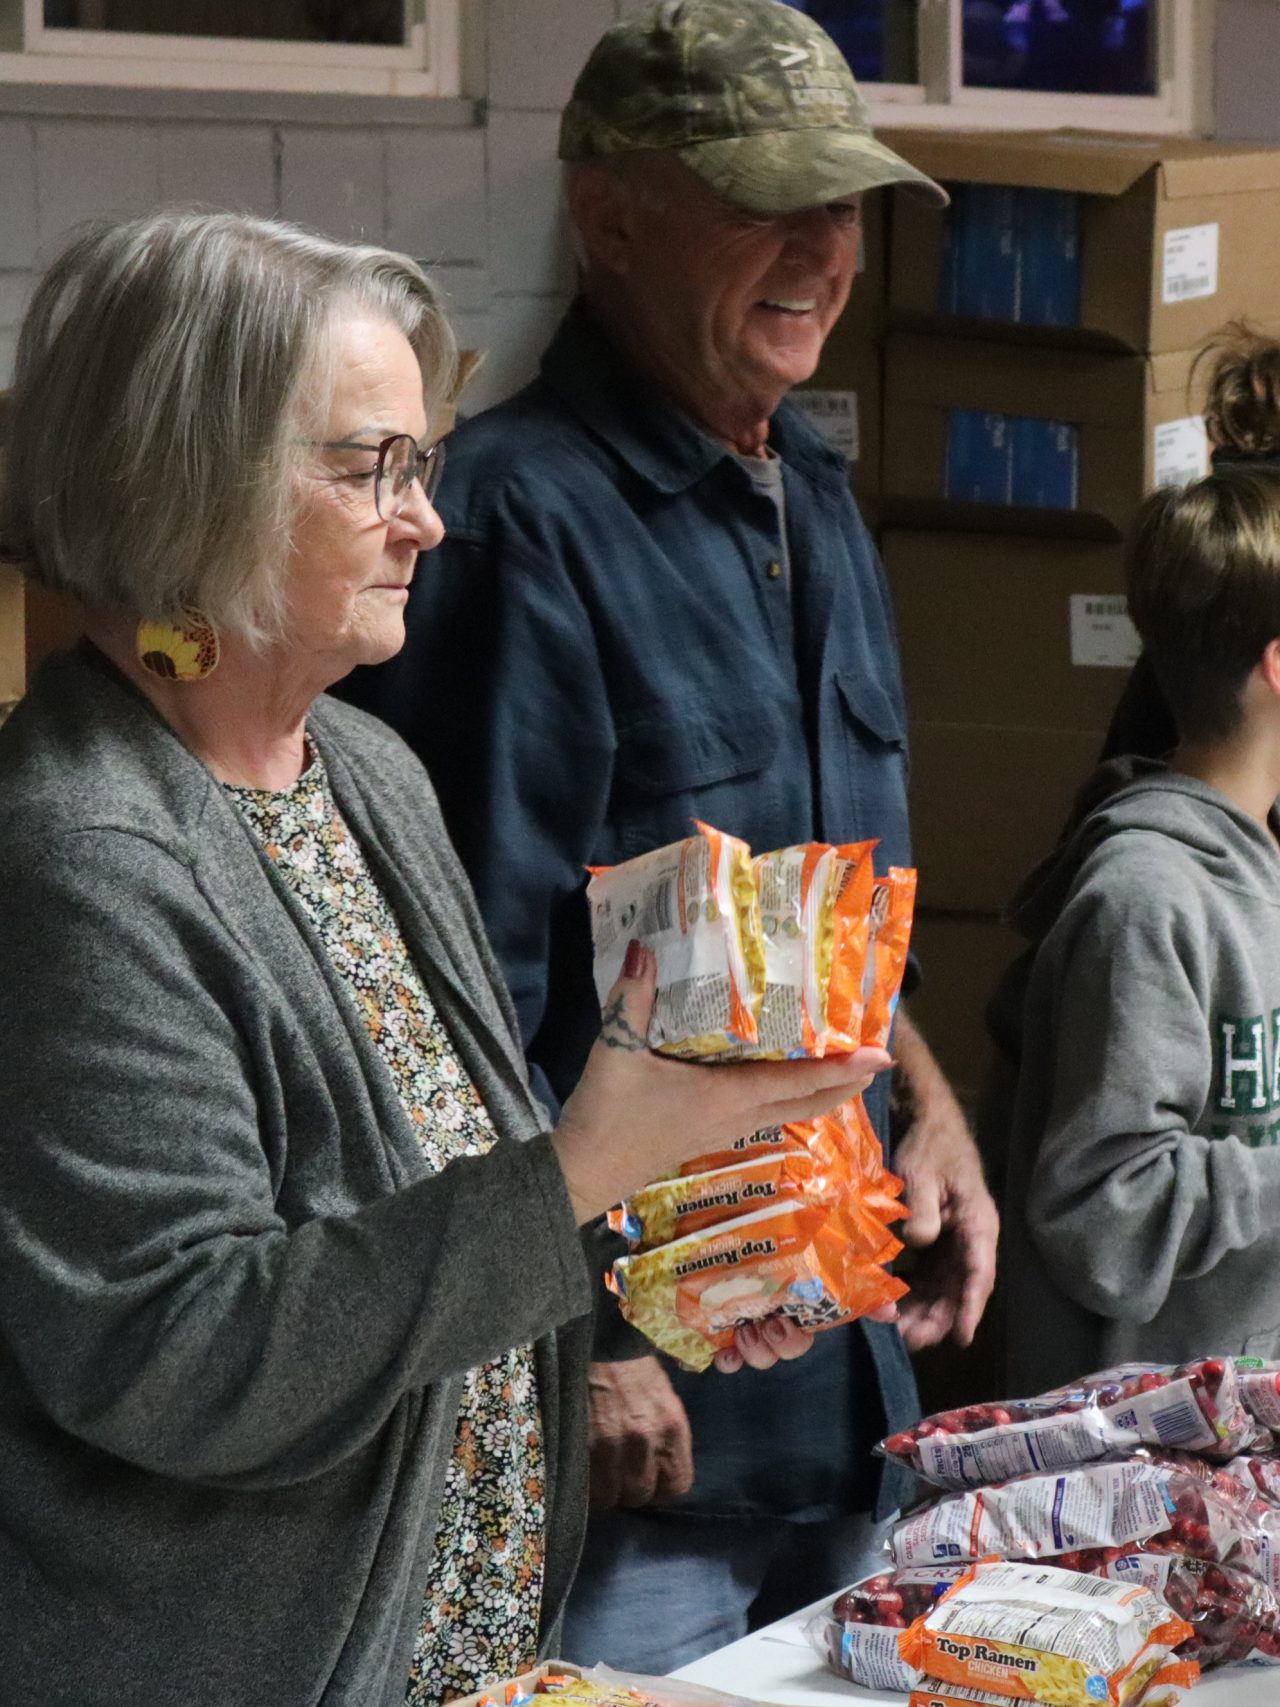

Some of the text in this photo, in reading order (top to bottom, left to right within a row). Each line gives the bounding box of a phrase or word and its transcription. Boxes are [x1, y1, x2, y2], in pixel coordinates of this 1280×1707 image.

[743, 1182, 776, 1198] Top
[676, 1191, 739, 1215] Ramen
[742, 1239, 776, 1256] Top
[675, 1249, 739, 1275] Ramen
[936, 1638, 1037, 1671] Top Ramen
[967, 1660, 1009, 1678] CHICKEN
